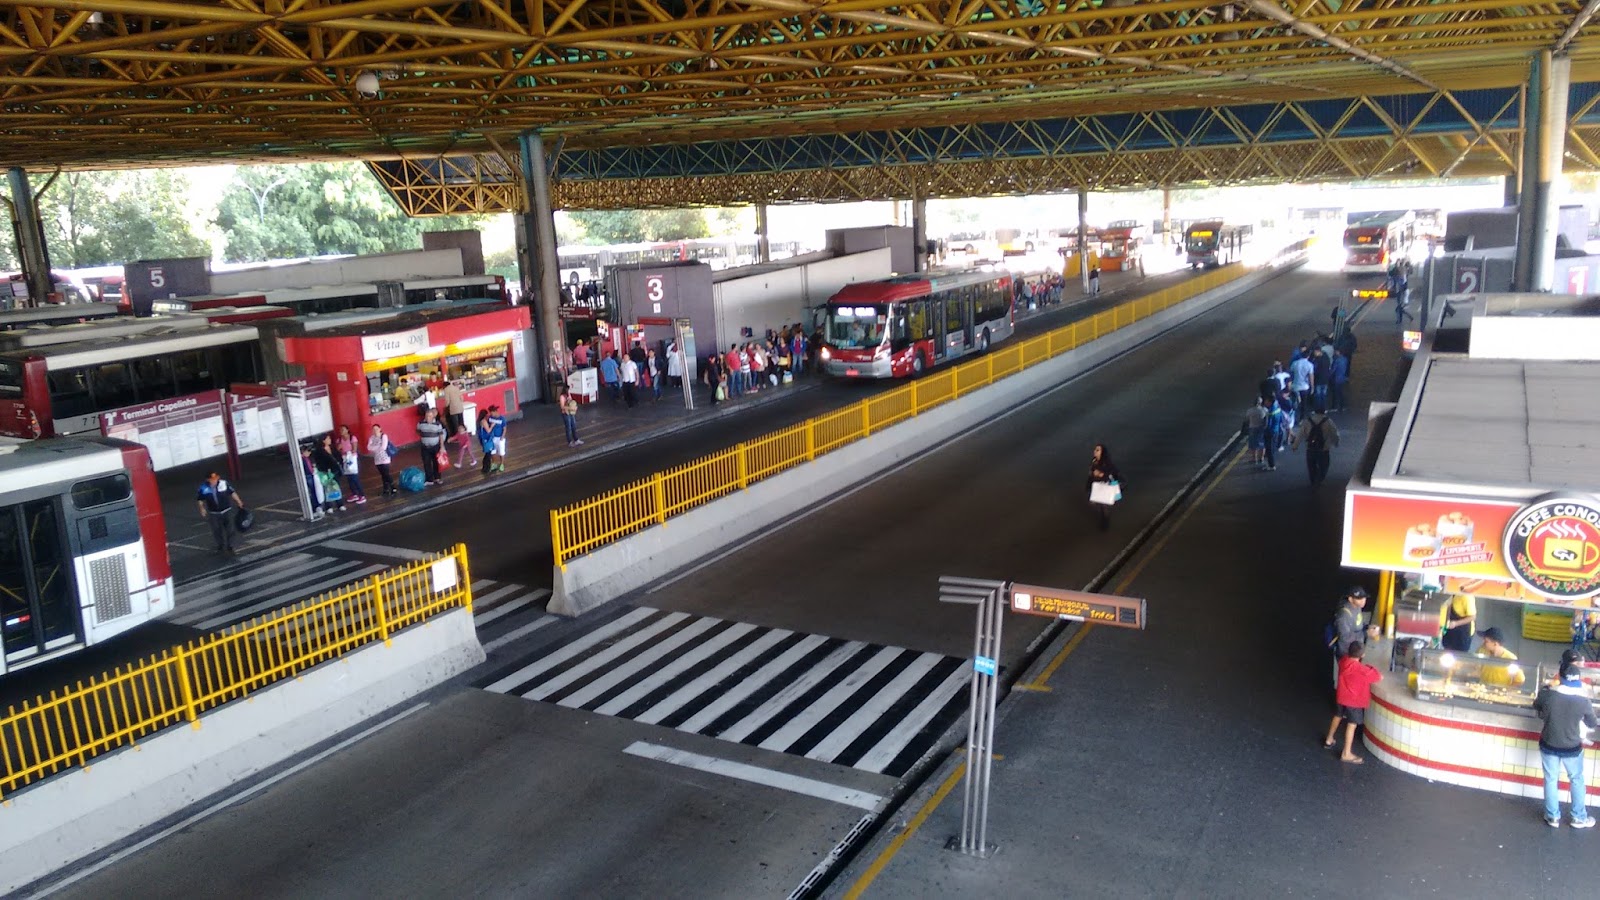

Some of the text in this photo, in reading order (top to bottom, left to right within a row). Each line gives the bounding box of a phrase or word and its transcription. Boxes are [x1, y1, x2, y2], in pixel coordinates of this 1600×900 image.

[150, 269, 165, 288] 5
[647, 278, 664, 301] 3
[1460, 271, 1477, 294] 2
[1571, 270, 1585, 295] 1
[374, 333, 424, 351] Vitta Dog
[121, 405, 157, 421] Terminal
[158, 398, 197, 413] Capelinha
